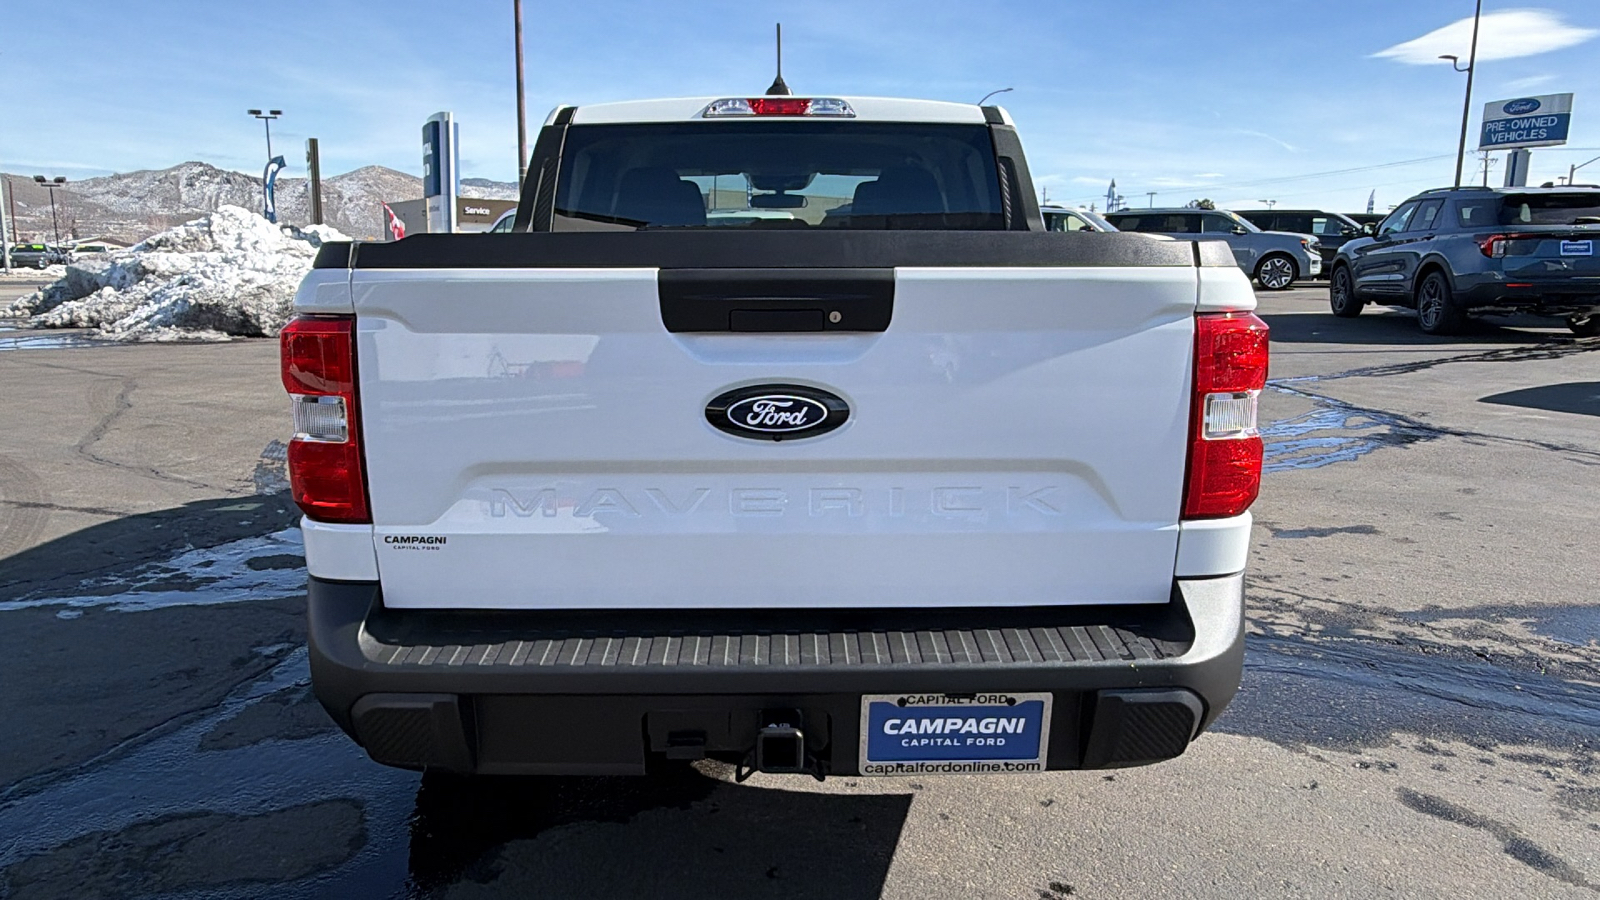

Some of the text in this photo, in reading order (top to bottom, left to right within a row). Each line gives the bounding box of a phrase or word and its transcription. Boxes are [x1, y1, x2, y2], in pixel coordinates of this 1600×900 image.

[1509, 101, 1532, 112] Ford
[1485, 116, 1558, 133] PRE-OWNED
[1491, 128, 1547, 143] VEHICLES
[464, 206, 490, 215] Service
[746, 400, 809, 426] Ford
[490, 486, 1062, 518] MAVERICK
[384, 535, 447, 545] CAMPAGNI
[906, 695, 965, 705] CAPITAL
[883, 717, 1026, 735] CAMPAGNI
[901, 738, 1006, 747] CAPITAL FORD
[864, 761, 1041, 776] capitalfordonline.com
